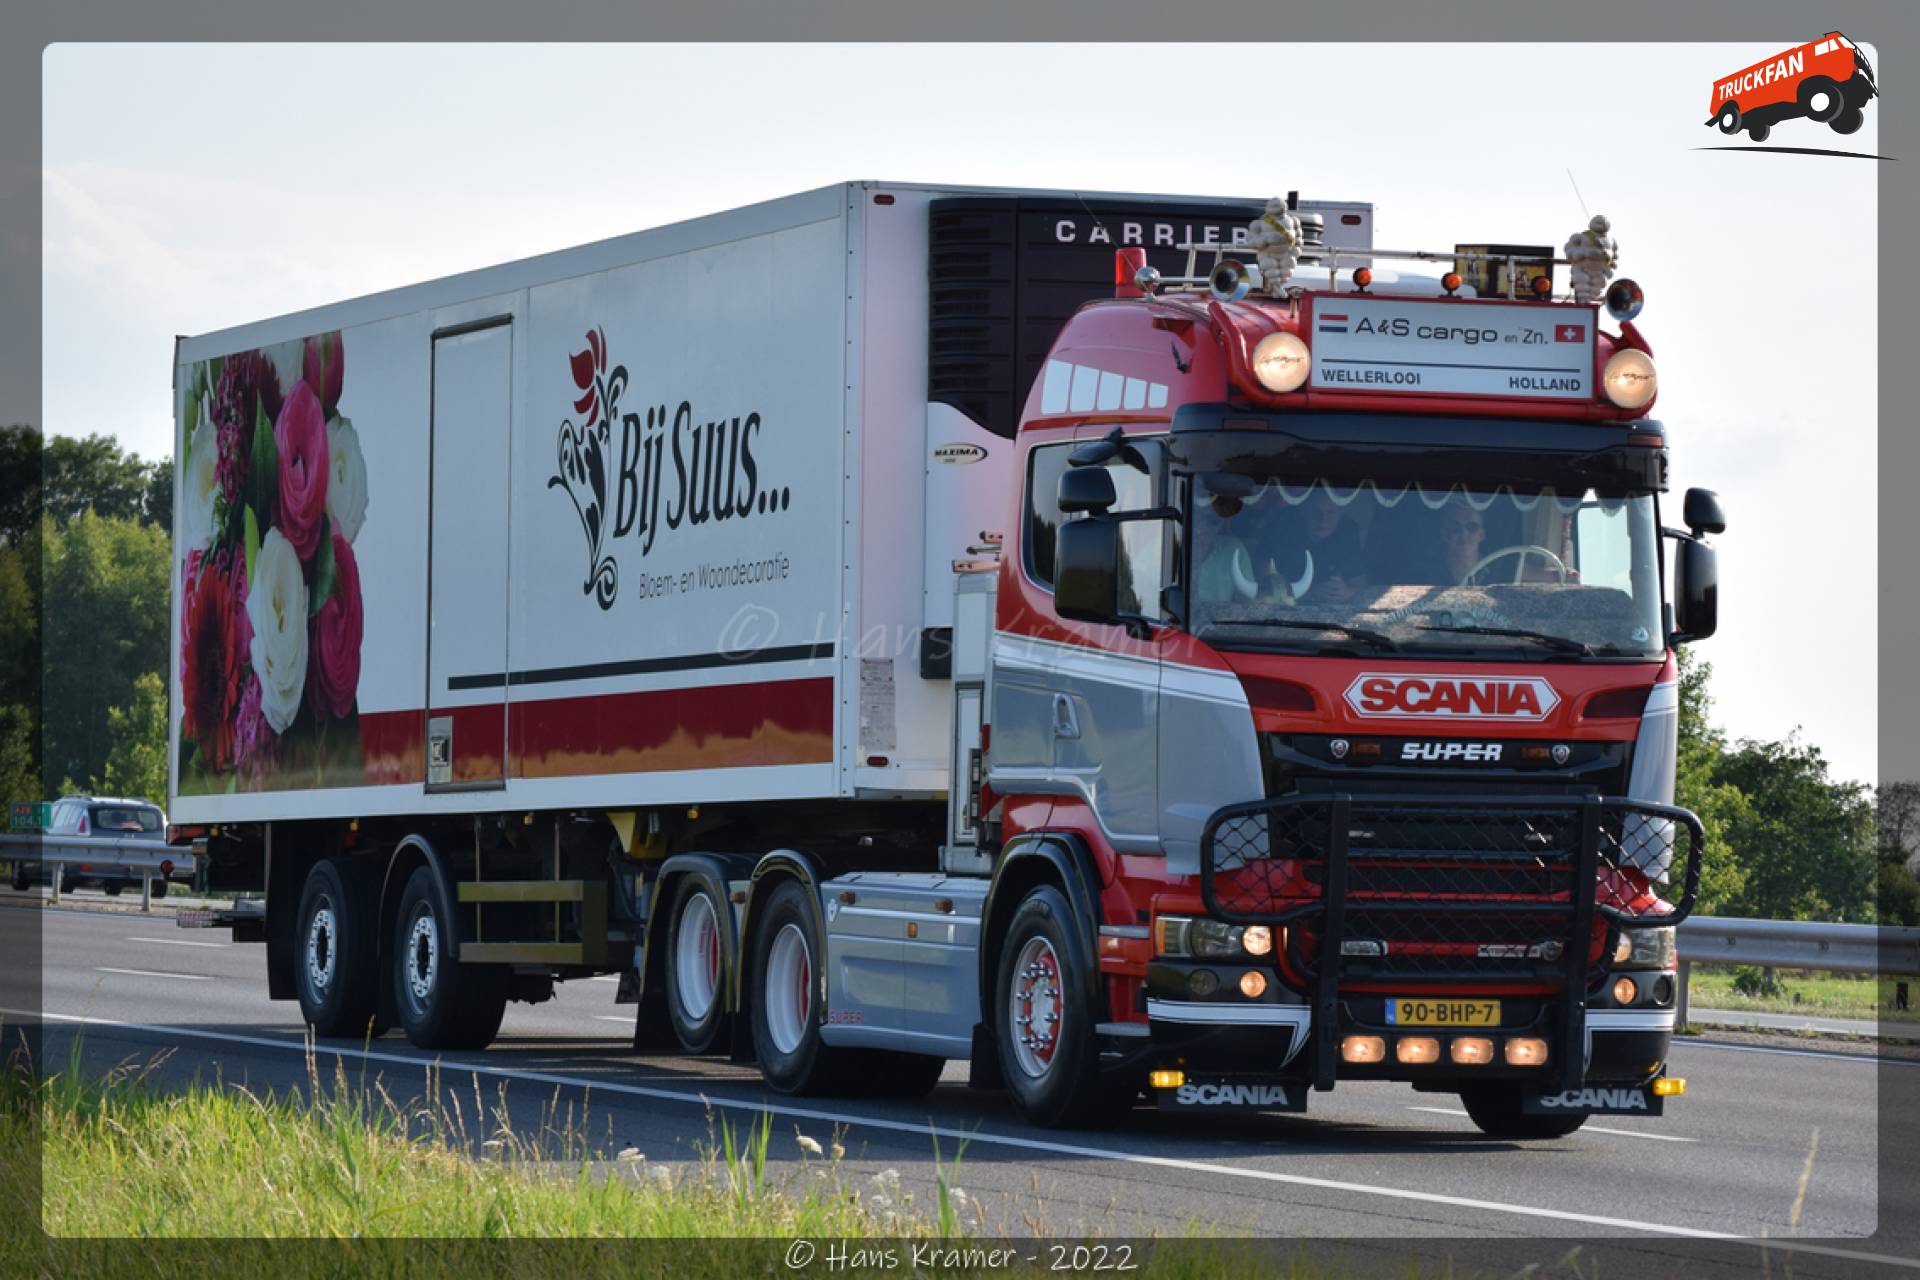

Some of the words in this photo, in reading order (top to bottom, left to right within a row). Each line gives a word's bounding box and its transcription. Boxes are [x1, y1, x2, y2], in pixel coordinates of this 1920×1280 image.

[1055, 219, 1250, 246] CARRIER
[1355, 317, 1410, 337] A&S
[1416, 324, 1498, 345] cargo
[1504, 332, 1518, 344] en
[1522, 328, 1549, 345] Zn.
[1321, 368, 1421, 386] WELLERLOOI
[1509, 376, 1581, 392] HOLLAND
[613, 404, 666, 557] Bij
[639, 572, 677, 599] Bloem-
[680, 571, 695, 593] en
[1359, 678, 1542, 715] SCANIA
[1401, 742, 1502, 761] SUPER
[1401, 1003, 1494, 1022] 90-BHP-7
[1176, 1084, 1288, 1105] SCANIA
[1540, 1088, 1648, 1109] SCANIA
